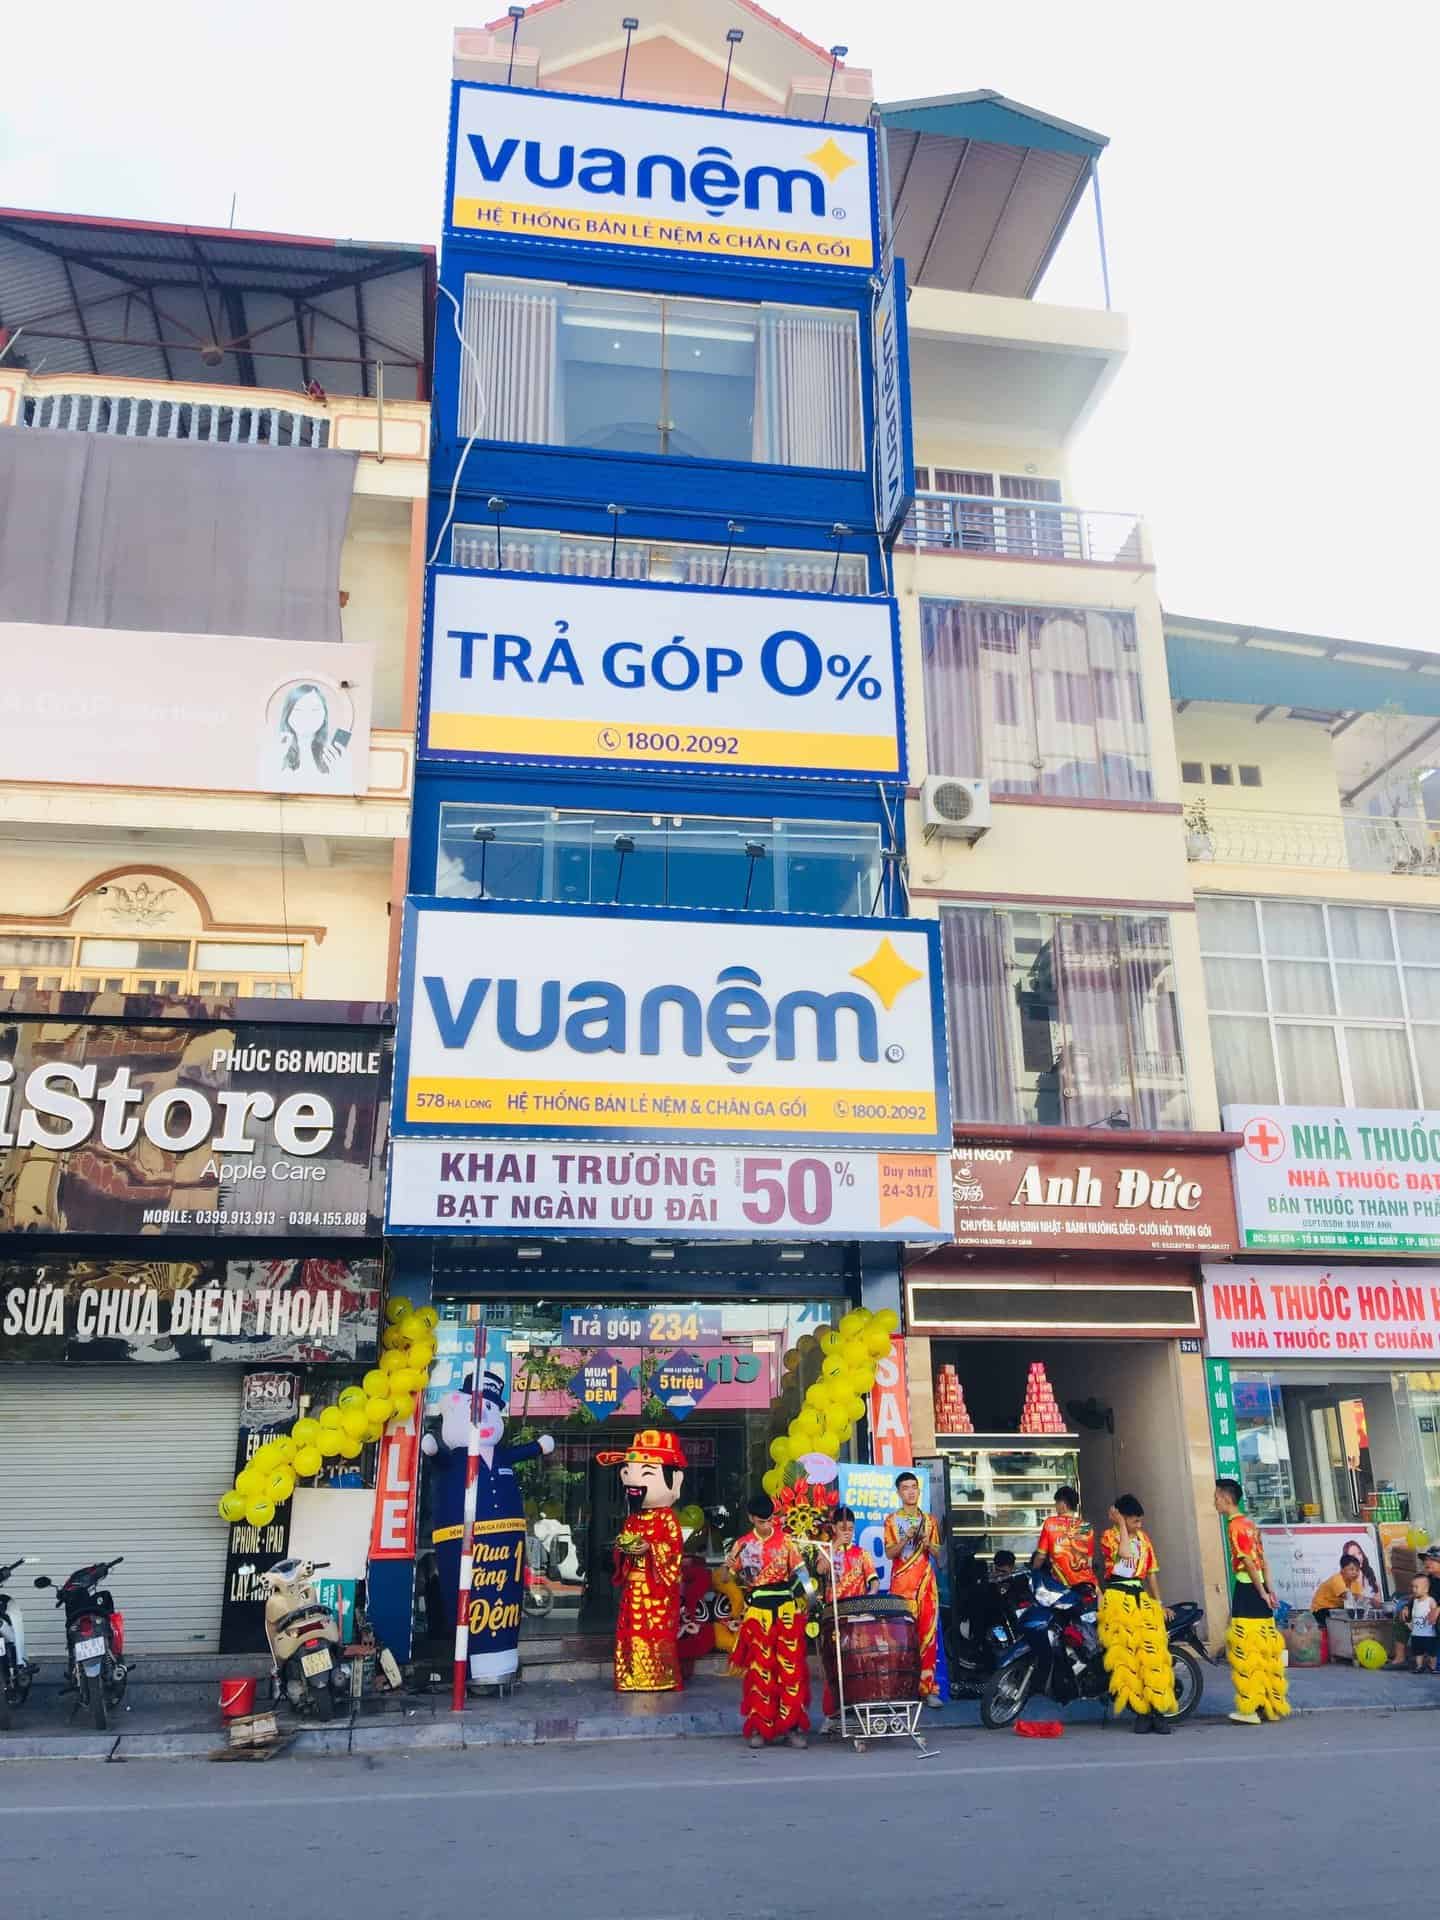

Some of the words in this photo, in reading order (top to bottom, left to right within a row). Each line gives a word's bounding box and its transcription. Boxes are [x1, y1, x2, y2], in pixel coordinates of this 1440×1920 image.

[466, 133, 826, 217] vuanệm
[477, 206, 504, 226] HỆ
[511, 208, 581, 232] THỐNG
[708, 232, 721, 246] &
[785, 238, 812, 255] GA
[816, 238, 851, 258] GỐI
[447, 619, 585, 686] TRẢ
[602, 635, 743, 694] GÓP
[626, 731, 740, 756] 1800.2092
[422, 965, 879, 1074] vuanệm
[212, 1044, 273, 1074] PHÚC
[279, 1051, 302, 1073] 68
[304, 1050, 380, 1075] MOBILE
[0, 1060, 335, 1157] iStore
[416, 1092, 445, 1108] 578
[464, 1099, 492, 1110] LONG
[508, 1091, 528, 1116] HỆ
[533, 1089, 590, 1112] THỐNG
[690, 1099, 702, 1114] &
[754, 1100, 775, 1117] GA
[779, 1096, 807, 1118] GỐI
[851, 1104, 927, 1120] 1800.2092
[1291, 1118, 1353, 1161] NHÀ
[1357, 1116, 1440, 1163] THUỐC
[440, 1152, 537, 1184] KHAI
[974, 1148, 1014, 1165] NGỌT
[200, 1159, 266, 1183] Apple
[271, 1160, 328, 1182] Care
[882, 1165, 904, 1180] Duy
[1287, 1166, 1331, 1188] NHÀ
[1336, 1165, 1401, 1191] THUỐC
[882, 1184, 936, 1199] 24-31/7
[1009, 1164, 1103, 1208] Anh
[1113, 1166, 1203, 1211] Đức
[143, 1209, 192, 1226] MOBILE:
[195, 1209, 276, 1226] 0399.913.913
[288, 1209, 367, 1226] 0384.155.888
[436, 1193, 499, 1224] BẠT
[511, 1190, 597, 1221] NGÀN
[611, 1194, 654, 1222] ƯU
[664, 1193, 718, 1222] ĐÃI
[1304, 1193, 1354, 1216] THUỐC
[1197, 1221, 1212, 1238] GÓI
[3, 1267, 66, 1337] SỬA
[77, 1279, 160, 1337] CHỮA
[1212, 1277, 1267, 1321] NHÀ
[1270, 1273, 1352, 1321] THUỐC
[1357, 1279, 1426, 1322] HOÀN
[570, 1313, 601, 1336] Trả
[606, 1317, 642, 1341] góp
[1231, 1327, 1269, 1349] NHÀ
[1273, 1325, 1331, 1349] THUỐC
[1336, 1332, 1369, 1353] ĐẠT
[1375, 1326, 1434, 1349] CHUẨN
[249, 1380, 291, 1399] 580
[584, 1367, 608, 1379] MUA
[608, 1365, 618, 1389] 1
[585, 1378, 608, 1391] TẶNG
[660, 1374, 669, 1390] 5
[671, 1374, 704, 1393] triệu
[584, 1389, 617, 1405] ĐỆM
[231, 1525, 261, 1554] IPHONE
[265, 1525, 285, 1553] IPAD
[472, 1542, 511, 1563] Mua
[514, 1540, 524, 1582] 1
[469, 1597, 520, 1637] Đệm
